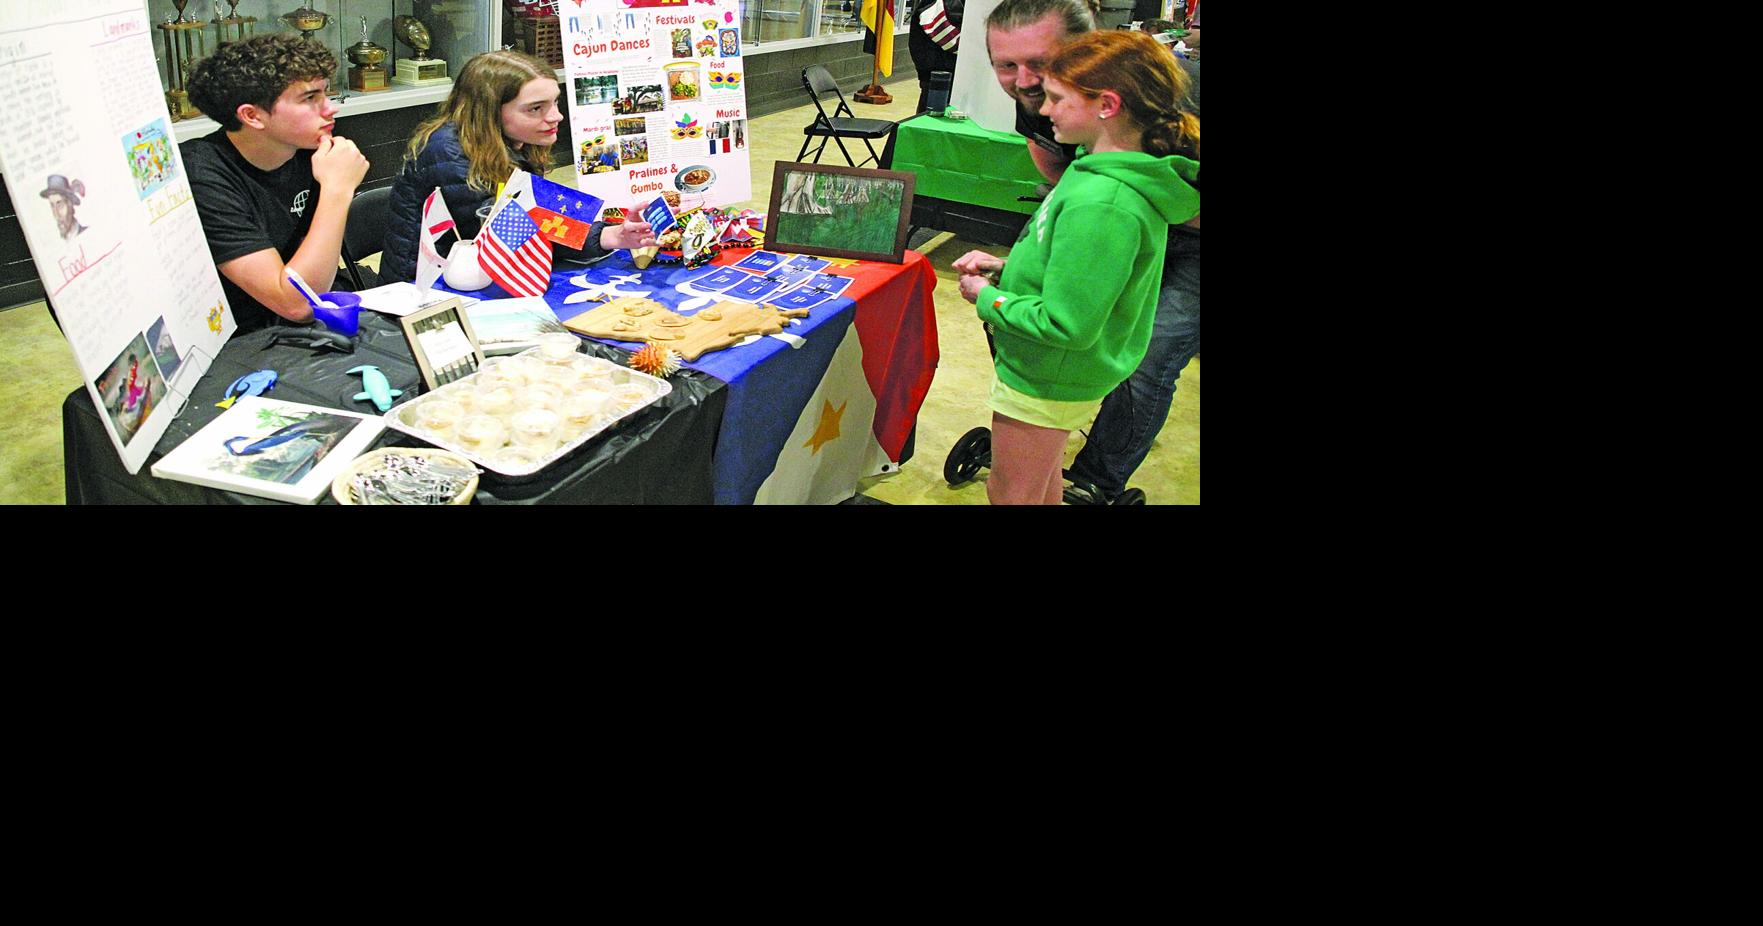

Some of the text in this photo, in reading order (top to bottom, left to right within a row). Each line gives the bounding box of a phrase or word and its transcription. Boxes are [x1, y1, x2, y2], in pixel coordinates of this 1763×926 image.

[655, 15, 696, 25] Festivals
[573, 43, 607, 58] Cajun
[610, 38, 650, 51] Dances
[710, 61, 725, 69] Food
[716, 108, 740, 118] Music
[629, 163, 679, 180] Pralines &
[630, 181, 664, 195] Gumbo
[58, 244, 88, 281] Food
